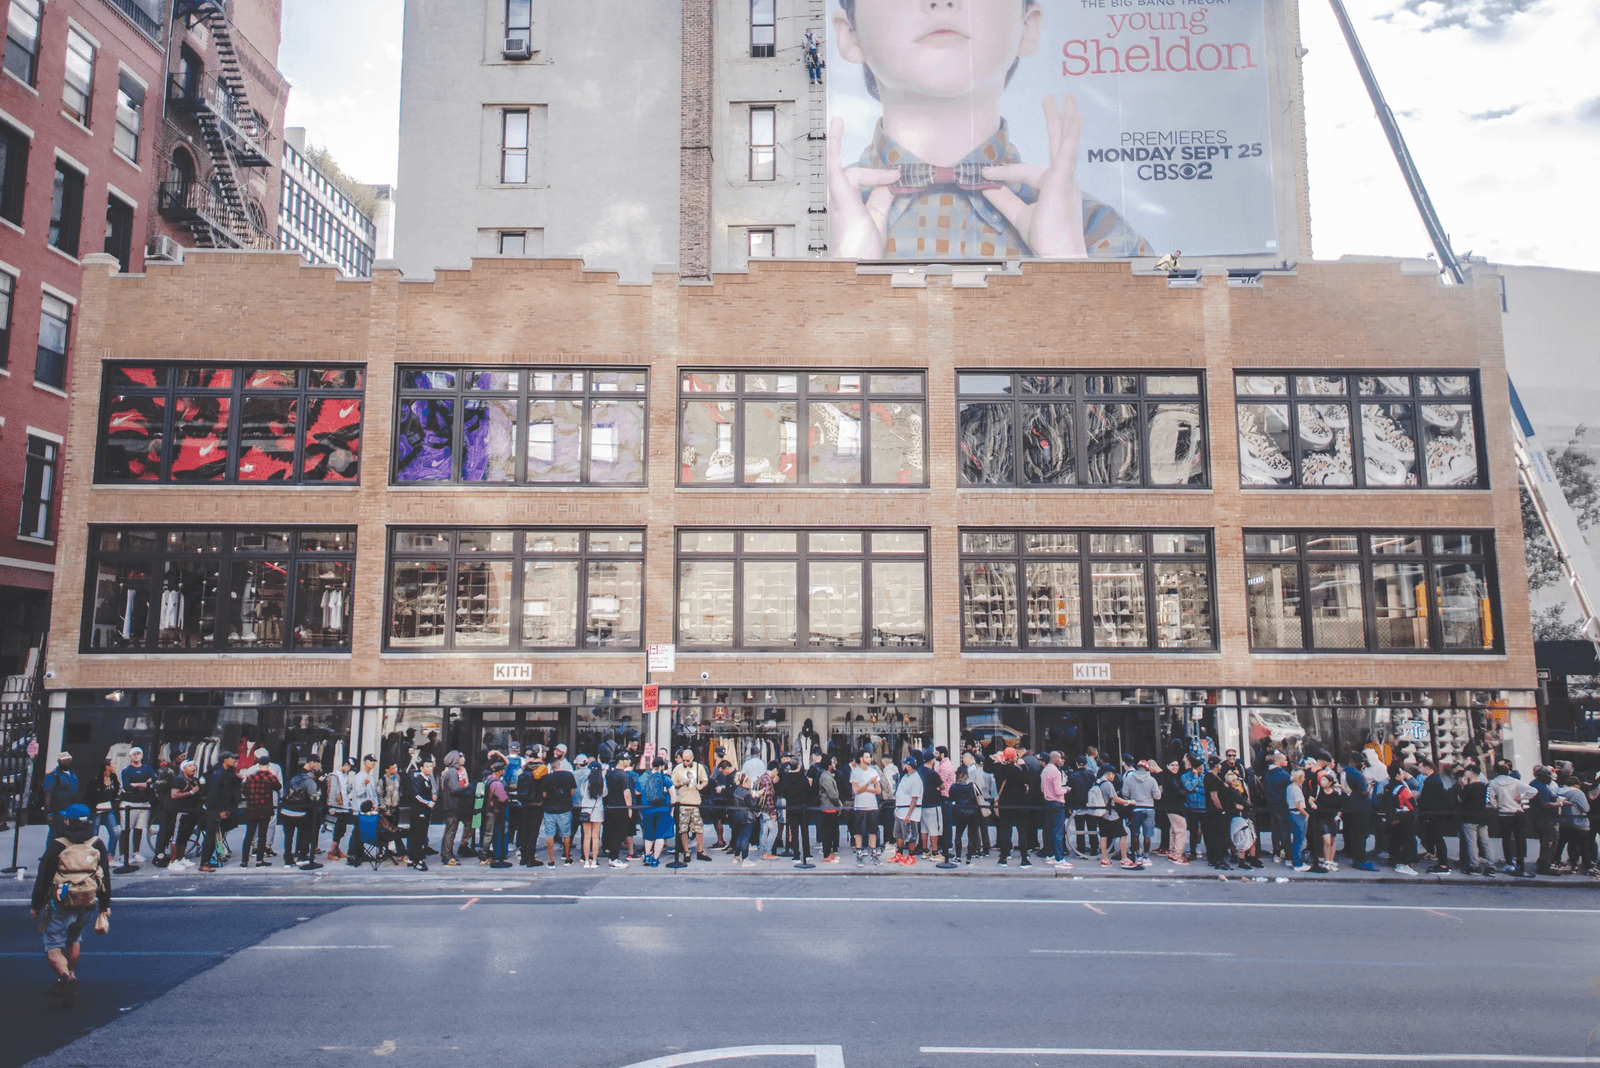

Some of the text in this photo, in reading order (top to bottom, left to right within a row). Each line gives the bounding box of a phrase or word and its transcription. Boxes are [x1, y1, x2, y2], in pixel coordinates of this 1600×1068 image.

[1081, 0, 1106, 8] THE
[1111, 0, 1133, 8] BIG
[1106, 8, 1208, 38] young
[1062, 35, 1258, 77] Sheldon
[1120, 130, 1228, 146] PREMIERES
[1087, 142, 1263, 163] MONDAY SEPT 25
[496, 665, 530, 678] KITH
[1075, 665, 1109, 678] KITH
